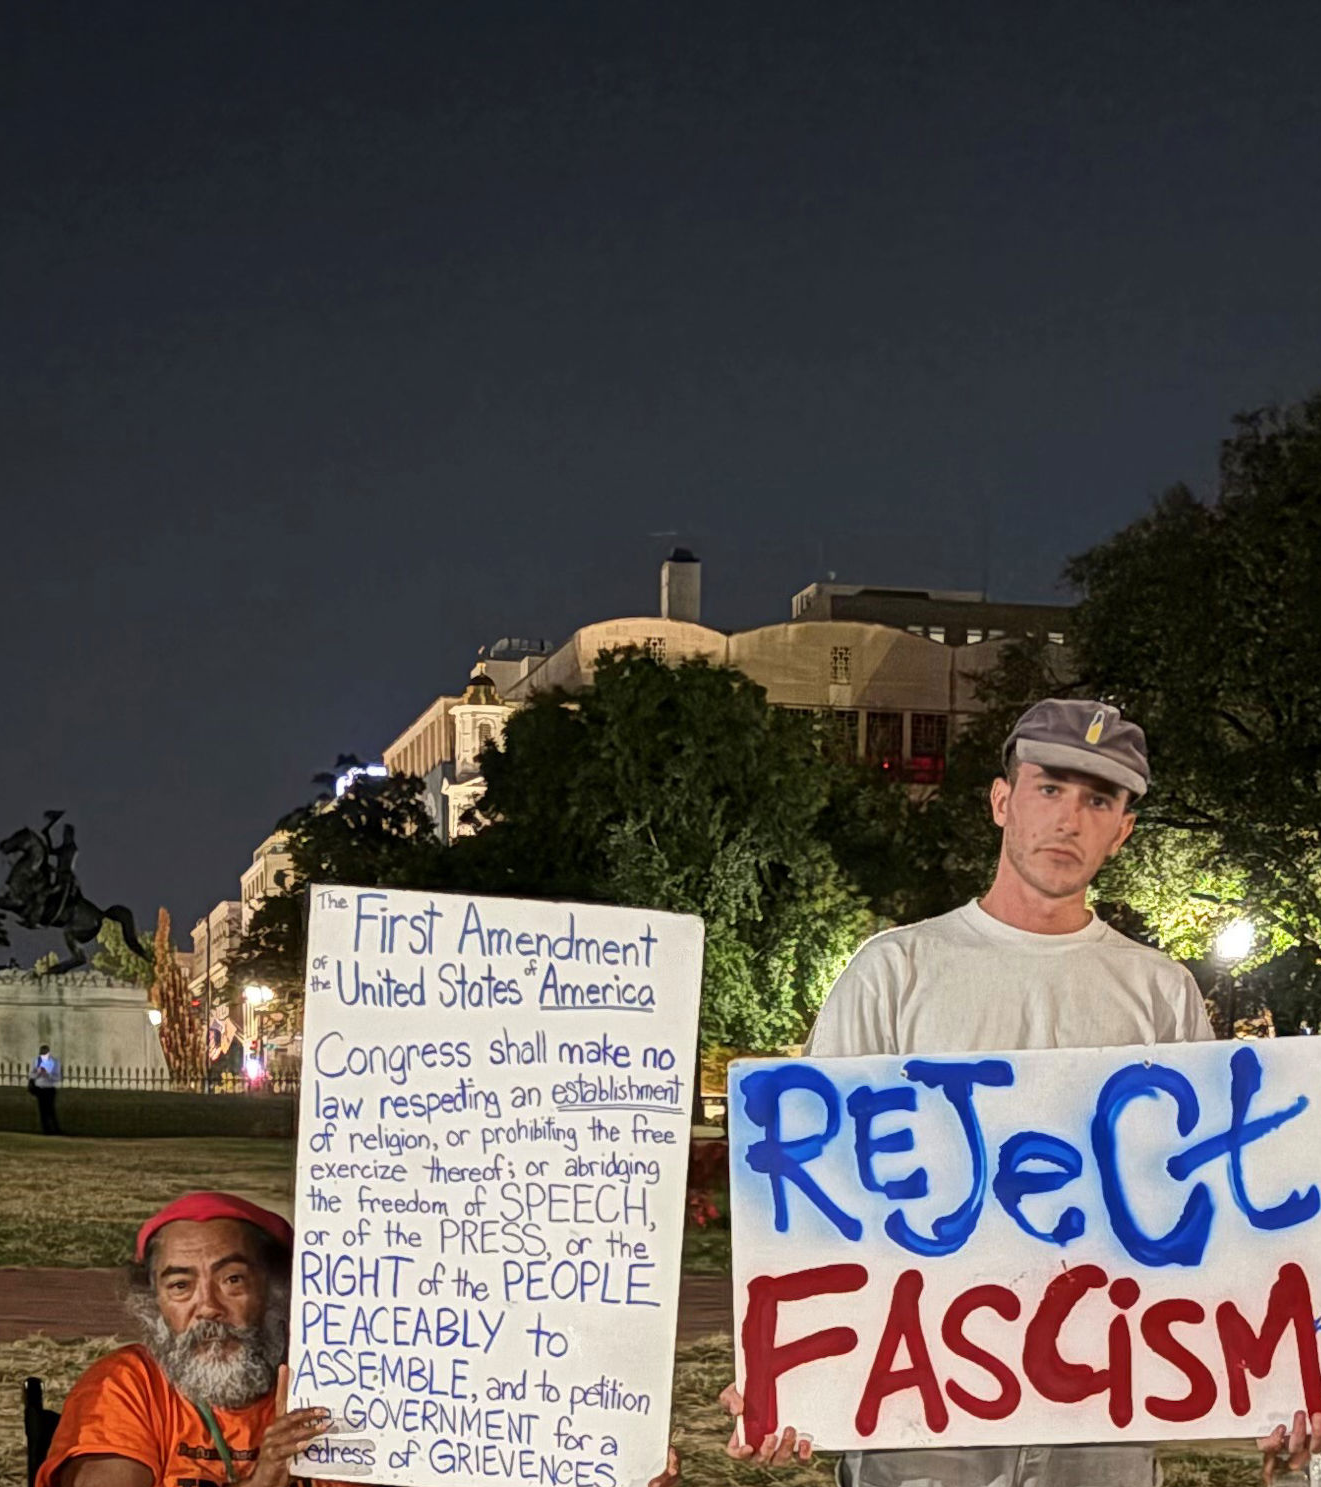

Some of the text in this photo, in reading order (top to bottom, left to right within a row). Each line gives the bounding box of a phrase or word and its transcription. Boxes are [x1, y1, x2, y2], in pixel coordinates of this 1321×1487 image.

[317, 891, 658, 968] The First Amendment
[310, 960, 656, 1010] the United States of America
[312, 956, 330, 970] of
[314, 1027, 675, 1085] Congress shall make no
[301, 1251, 661, 1308] RIGHT of the PEOPLE
[302, 1302, 568, 1357] PEACEABLY to
[292, 1350, 650, 1415] ASSEMBLE, and to petition
[388, 1439, 420, 1468] of
